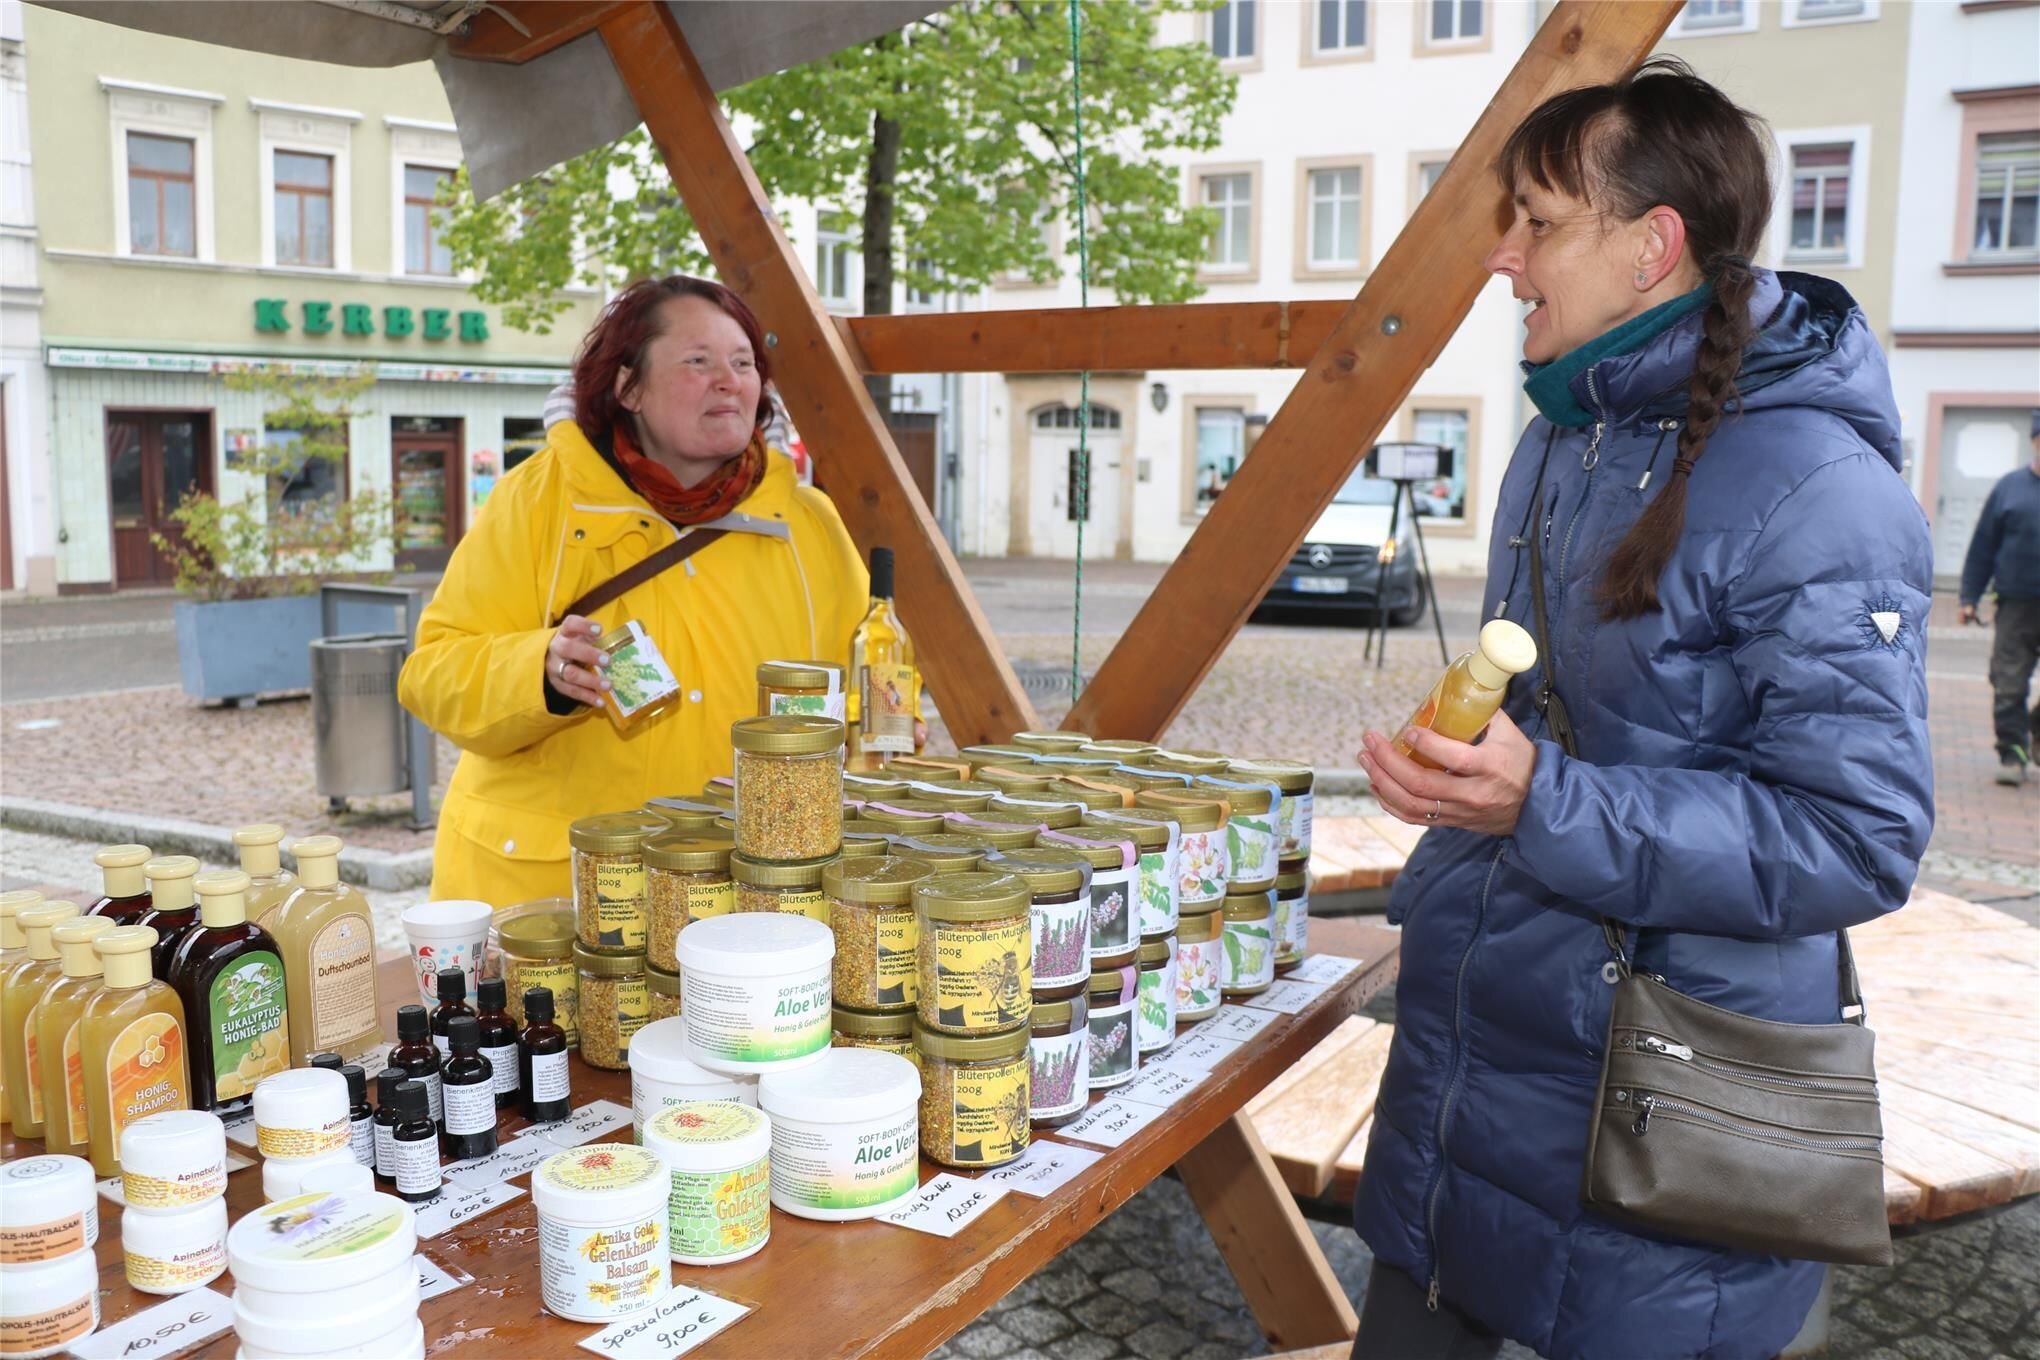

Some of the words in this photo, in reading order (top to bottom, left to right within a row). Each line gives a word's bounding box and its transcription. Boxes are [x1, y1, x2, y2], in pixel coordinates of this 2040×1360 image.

[254, 298, 489, 342] KERBER
[598, 878, 621, 888] 200g
[689, 899, 714, 909] 200g
[879, 929, 904, 939] 200g
[937, 930, 999, 944] Blütenpollen
[937, 946, 962, 958] 200g
[318, 951, 371, 977] Duftschaumbad
[619, 997, 641, 1005] 200g
[774, 999, 809, 1017] Aloe
[221, 1004, 281, 1034] EUKALYPTUS
[774, 1022, 797, 1033] Honig
[224, 1017, 281, 1045] HONIG-BAD
[957, 1066, 1015, 1081] Blütenpollen
[135, 1080, 172, 1101] HONIG-
[957, 1085, 982, 1096] 200g
[127, 1089, 178, 1116] SHAMPOO
[854, 1144, 892, 1165] Aloe
[895, 1131, 916, 1154] Vera
[177, 1164, 216, 1182] Apinatur
[854, 1170, 879, 1181] Honig
[880, 1169, 886, 1177] &
[991, 1160, 1035, 1181] Pollen
[595, 1230, 632, 1246] Arnika
[633, 1219, 655, 1239] Gold
[172, 1244, 214, 1262] Apinatur
[606, 1260, 649, 1280] Balsam
